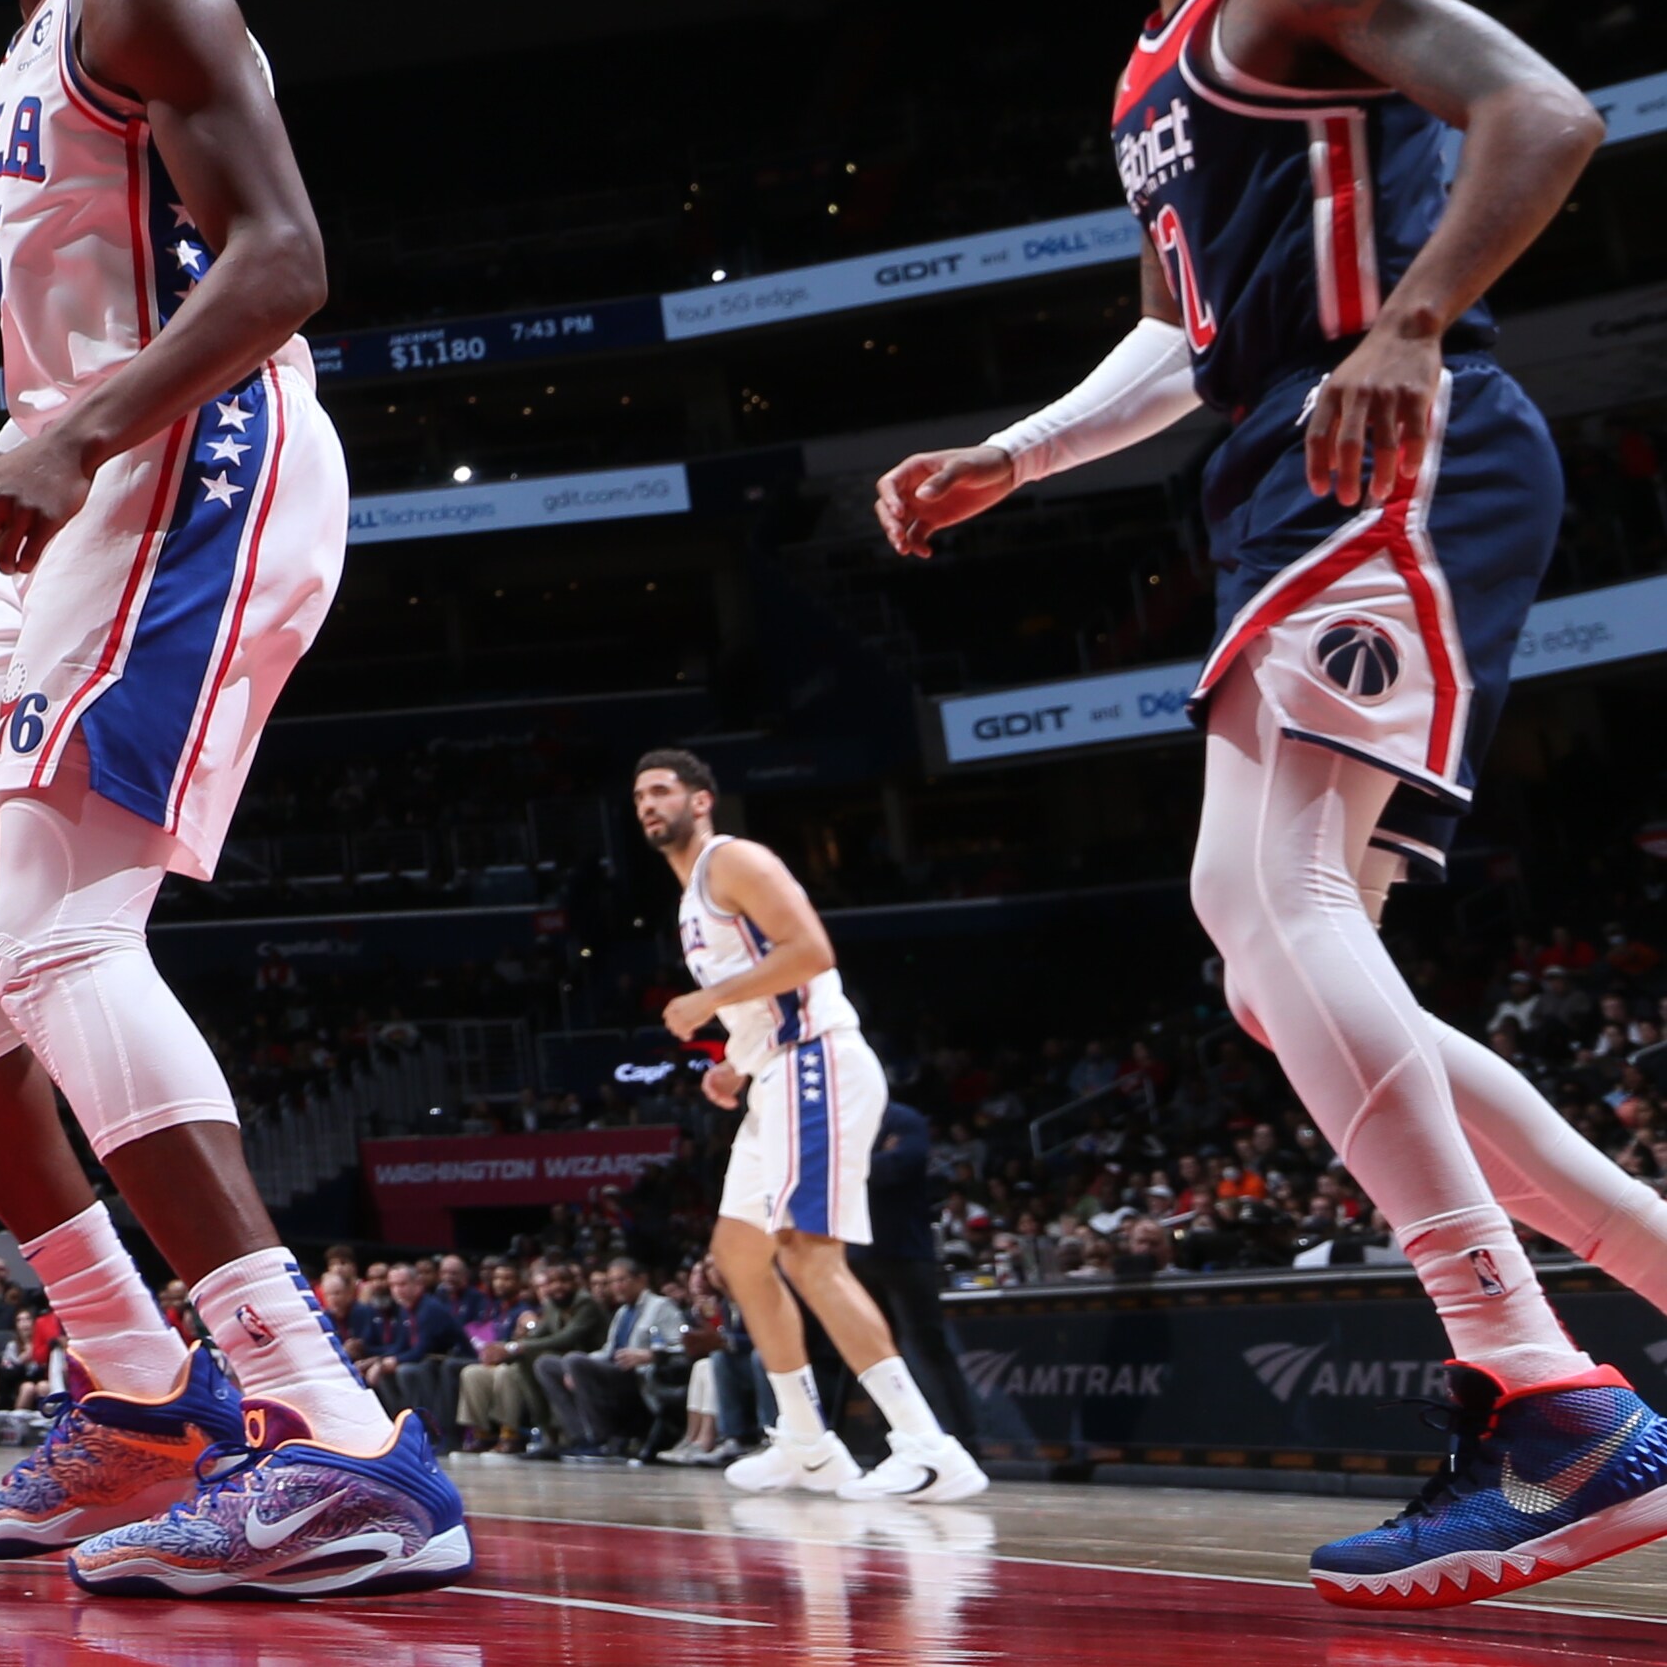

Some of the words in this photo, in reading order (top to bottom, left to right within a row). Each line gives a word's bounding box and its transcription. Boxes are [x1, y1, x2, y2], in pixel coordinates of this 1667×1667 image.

[875, 254, 965, 285] GDIT
[980, 248, 1008, 265] and
[1023, 236, 1088, 262] DELL
[672, 301, 717, 324] Your
[718, 294, 750, 313] 5G
[511, 319, 556, 342] 7:43
[561, 314, 594, 335] PM
[389, 337, 487, 371] $1,180
[543, 480, 670, 513] gdit.com/5G
[380, 500, 496, 528] Technologies
[973, 705, 1072, 742] GDIT
[1090, 703, 1121, 722] and
[374, 1158, 536, 1185] WASHINGTON
[1003, 1362, 1168, 1397] AMTRAK
[1308, 1360, 1449, 1398] AMTR
